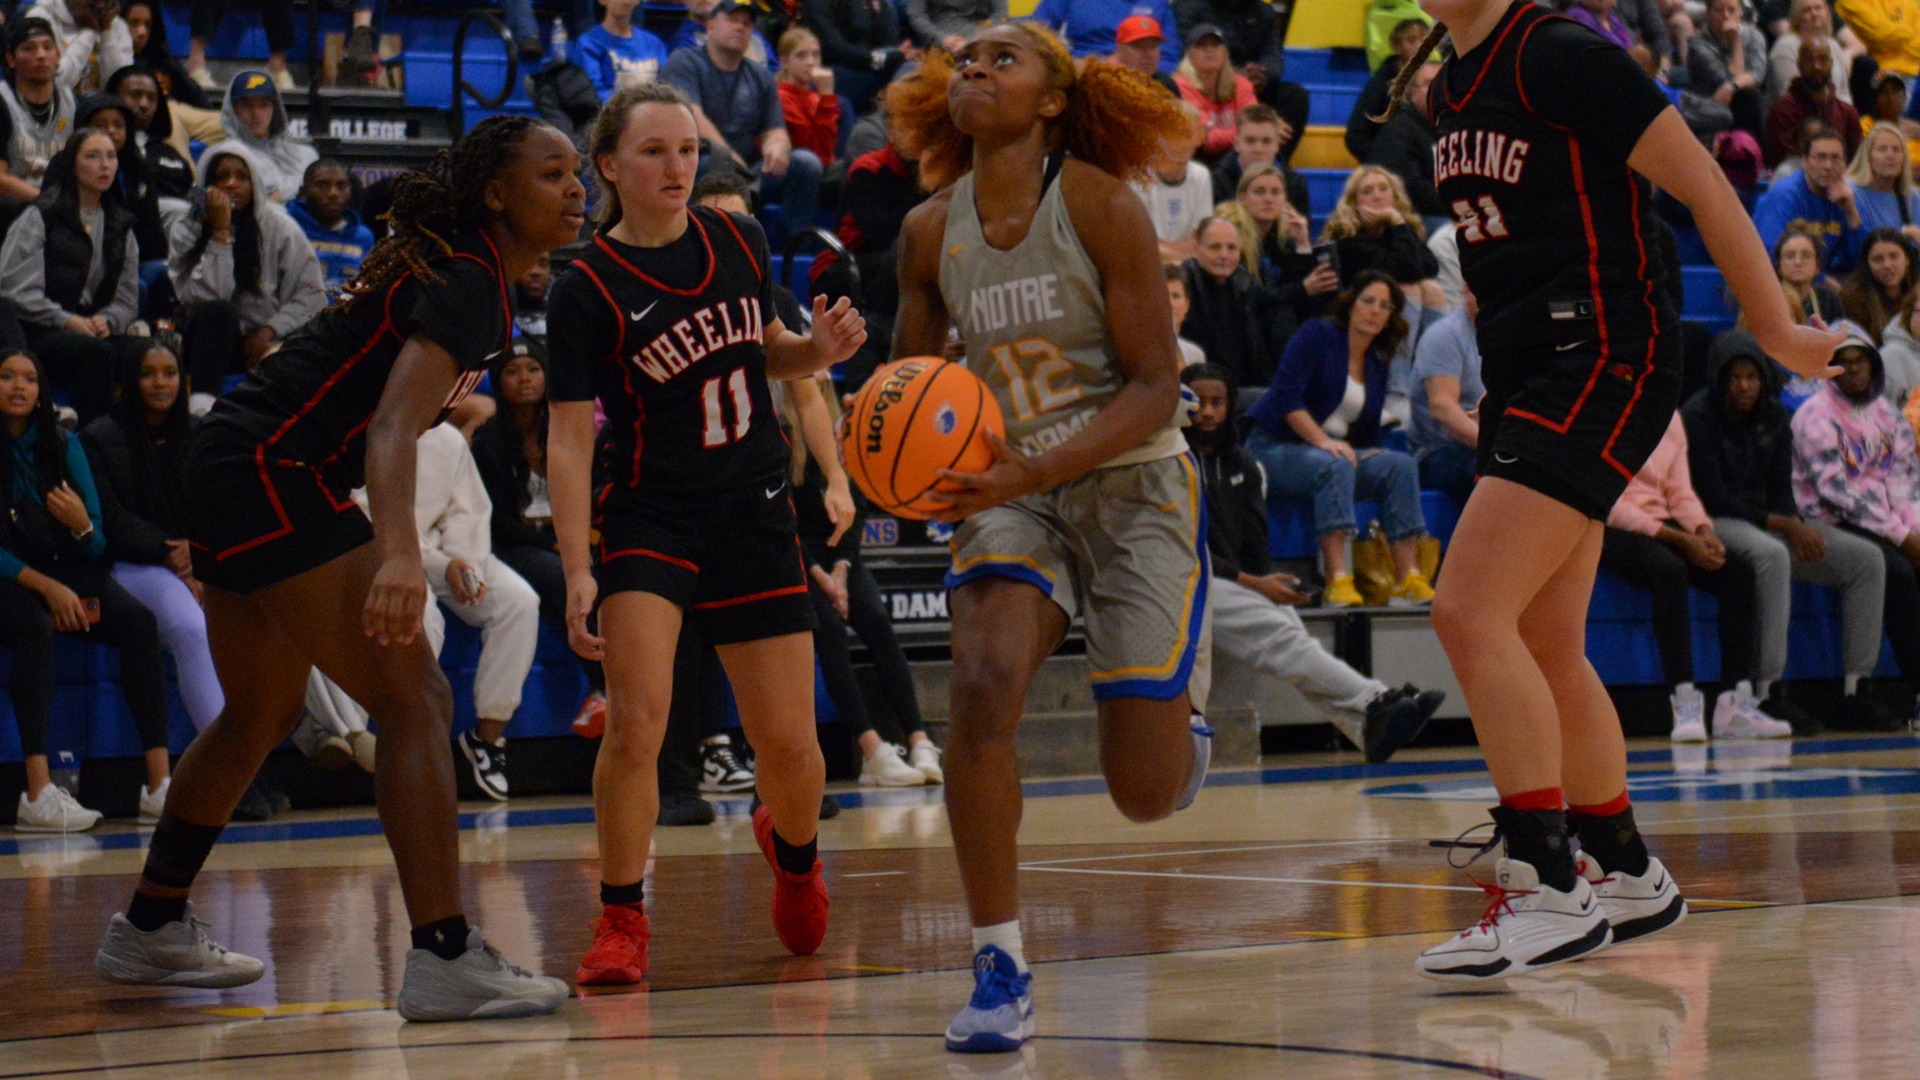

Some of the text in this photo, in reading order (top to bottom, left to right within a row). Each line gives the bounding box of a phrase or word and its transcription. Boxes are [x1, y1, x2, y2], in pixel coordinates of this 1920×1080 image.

[970, 273, 1064, 334] NOTRE
[702, 365, 754, 449] 11
[989, 336, 1083, 424] 12
